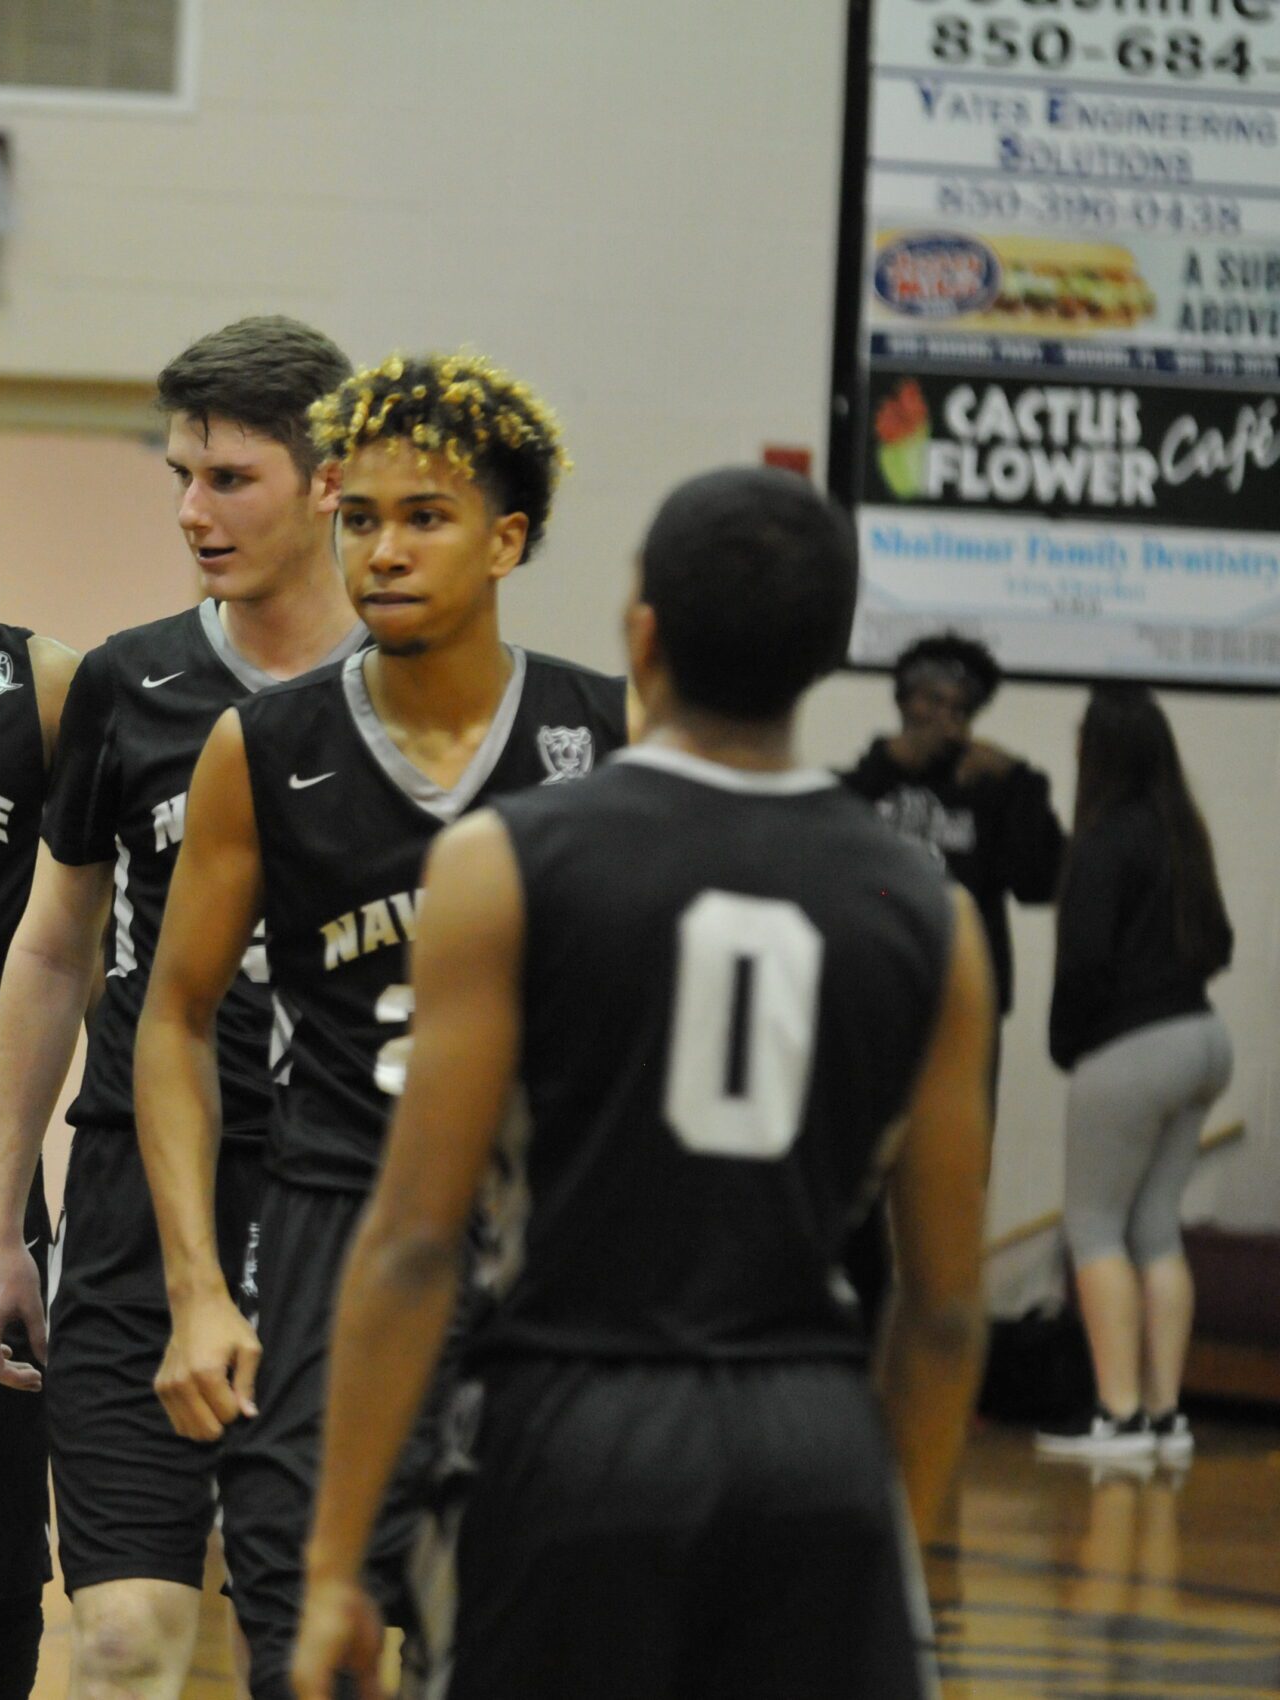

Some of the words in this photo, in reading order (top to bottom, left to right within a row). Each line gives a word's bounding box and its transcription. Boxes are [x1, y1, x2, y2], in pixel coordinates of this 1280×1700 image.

[1046, 86, 1279, 146] ENGINEERING
[999, 131, 1193, 185] SOLUTIONS
[944, 382, 1142, 446] CACTUS
[926, 440, 1160, 508] FLOWER
[664, 887, 826, 1163] 0
